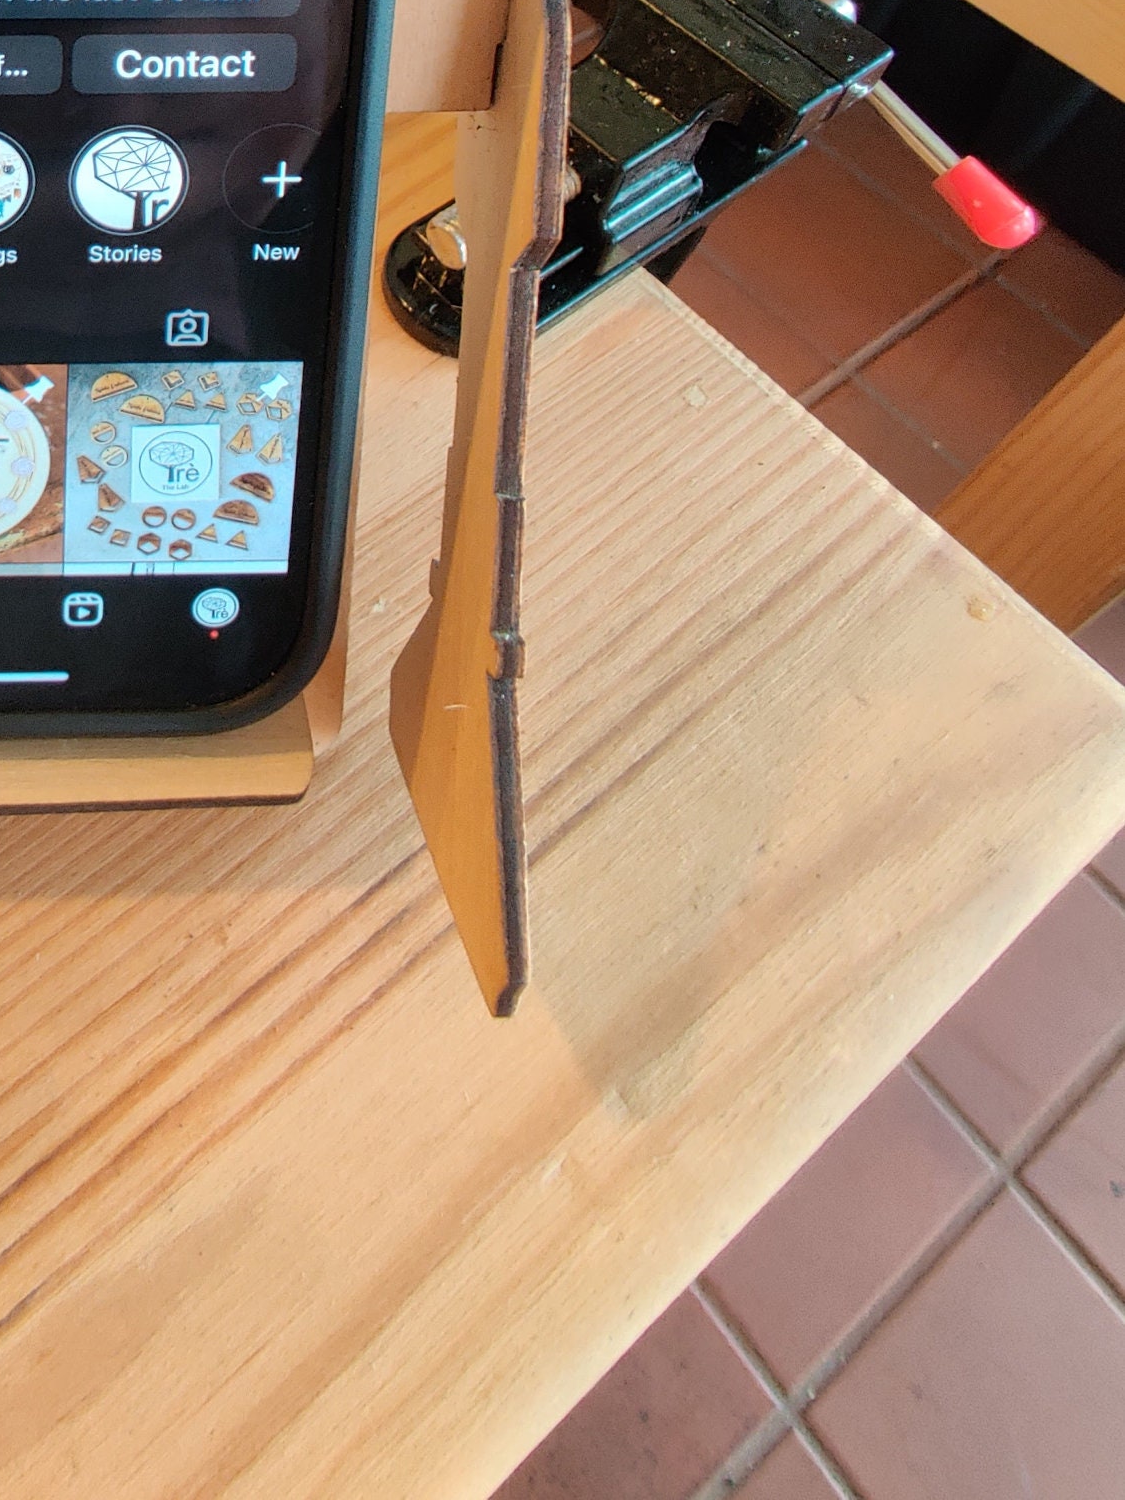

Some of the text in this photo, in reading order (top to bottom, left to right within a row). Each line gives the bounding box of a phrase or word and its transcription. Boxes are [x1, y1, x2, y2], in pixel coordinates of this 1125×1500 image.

[115, 49, 256, 80] Contact
[88, 244, 163, 263] Stories
[252, 243, 300, 261] New
[166, 462, 200, 483] Trè
